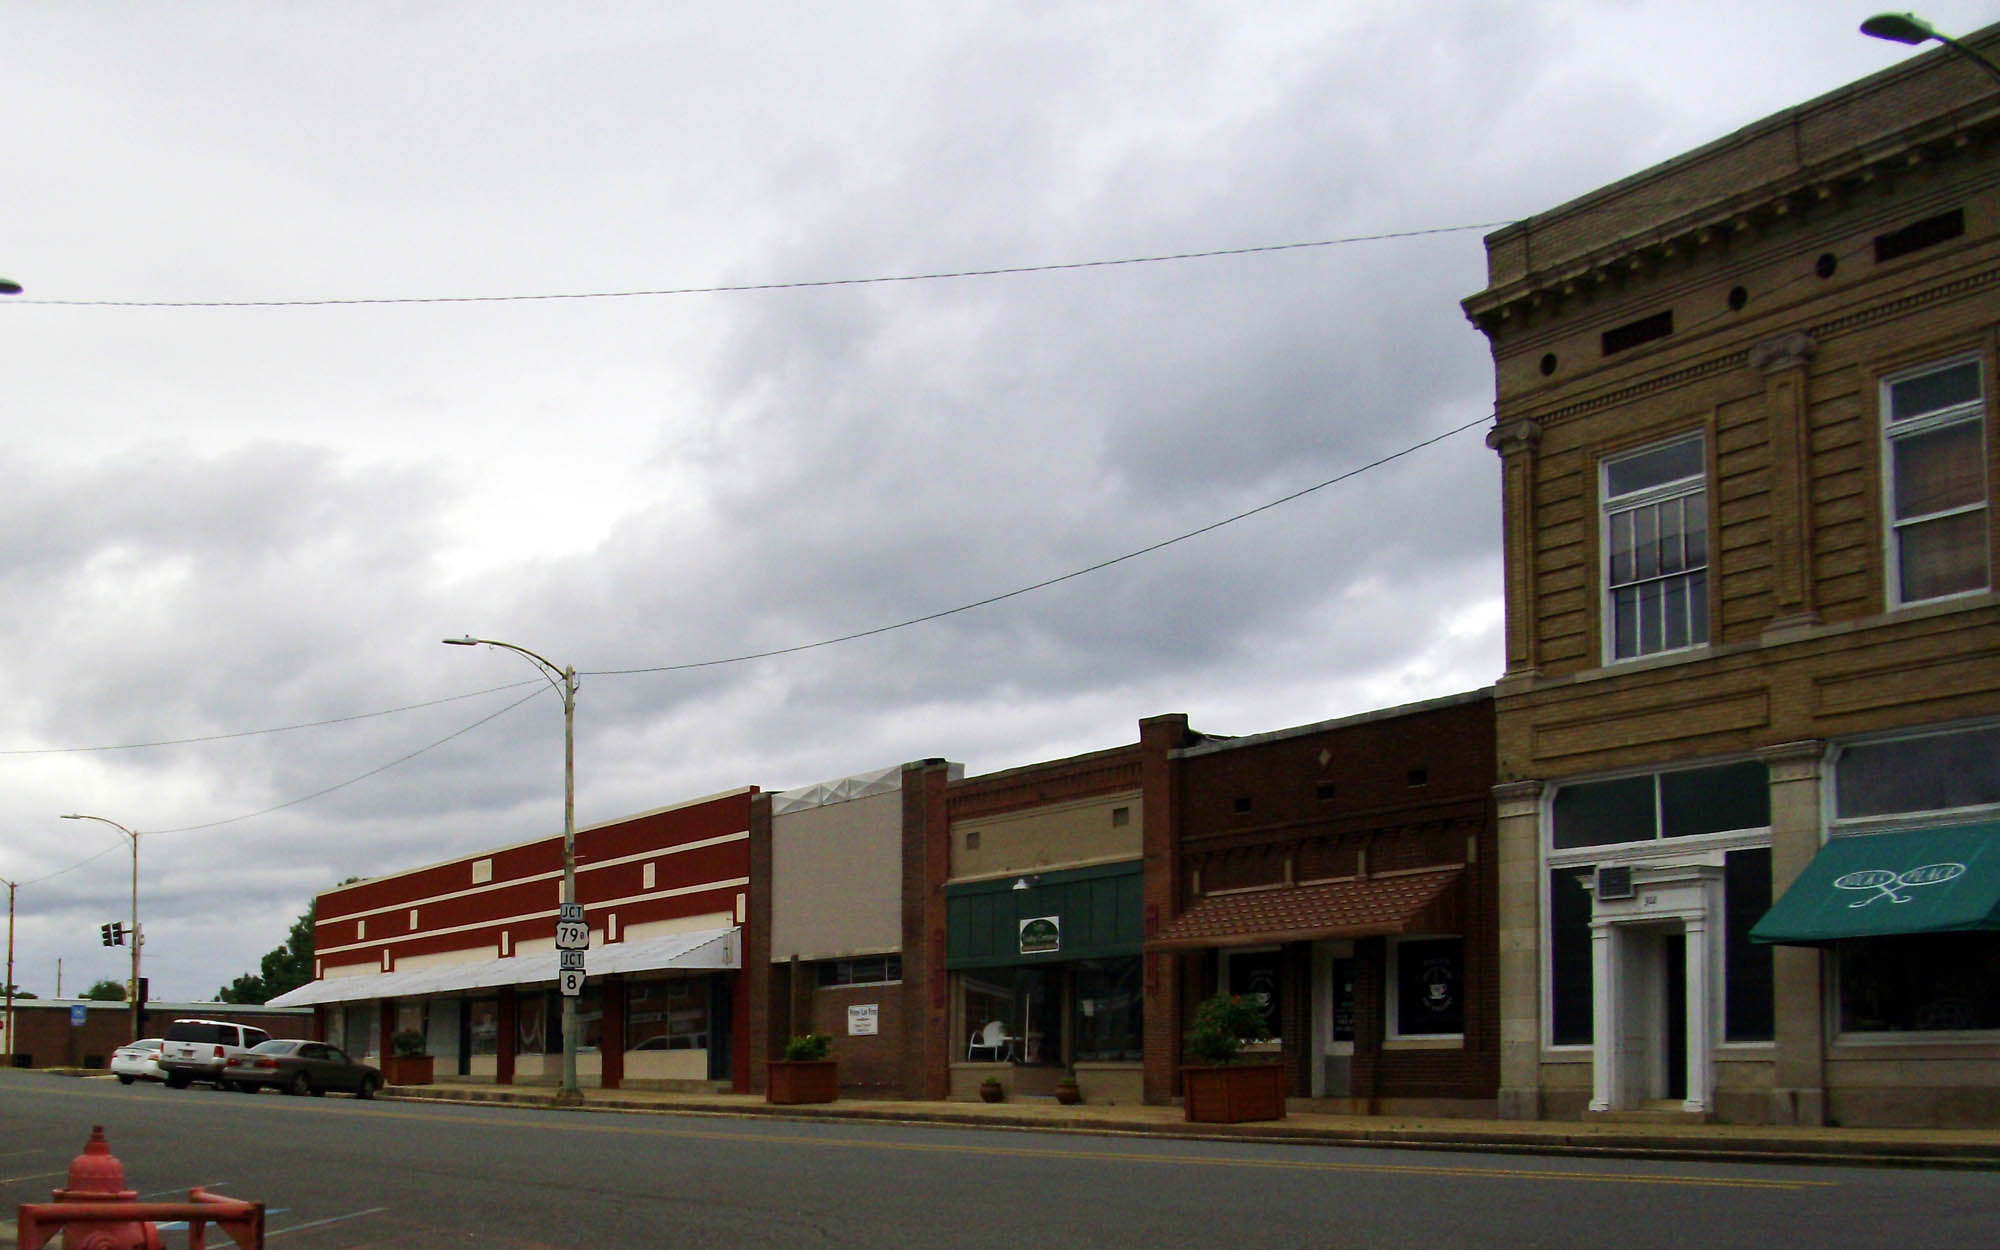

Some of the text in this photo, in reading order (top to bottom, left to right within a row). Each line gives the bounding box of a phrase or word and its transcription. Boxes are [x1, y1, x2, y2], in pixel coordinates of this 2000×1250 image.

[562, 906, 582, 918] JCT
[563, 954, 582, 965] JCT
[567, 975, 576, 990] 8
